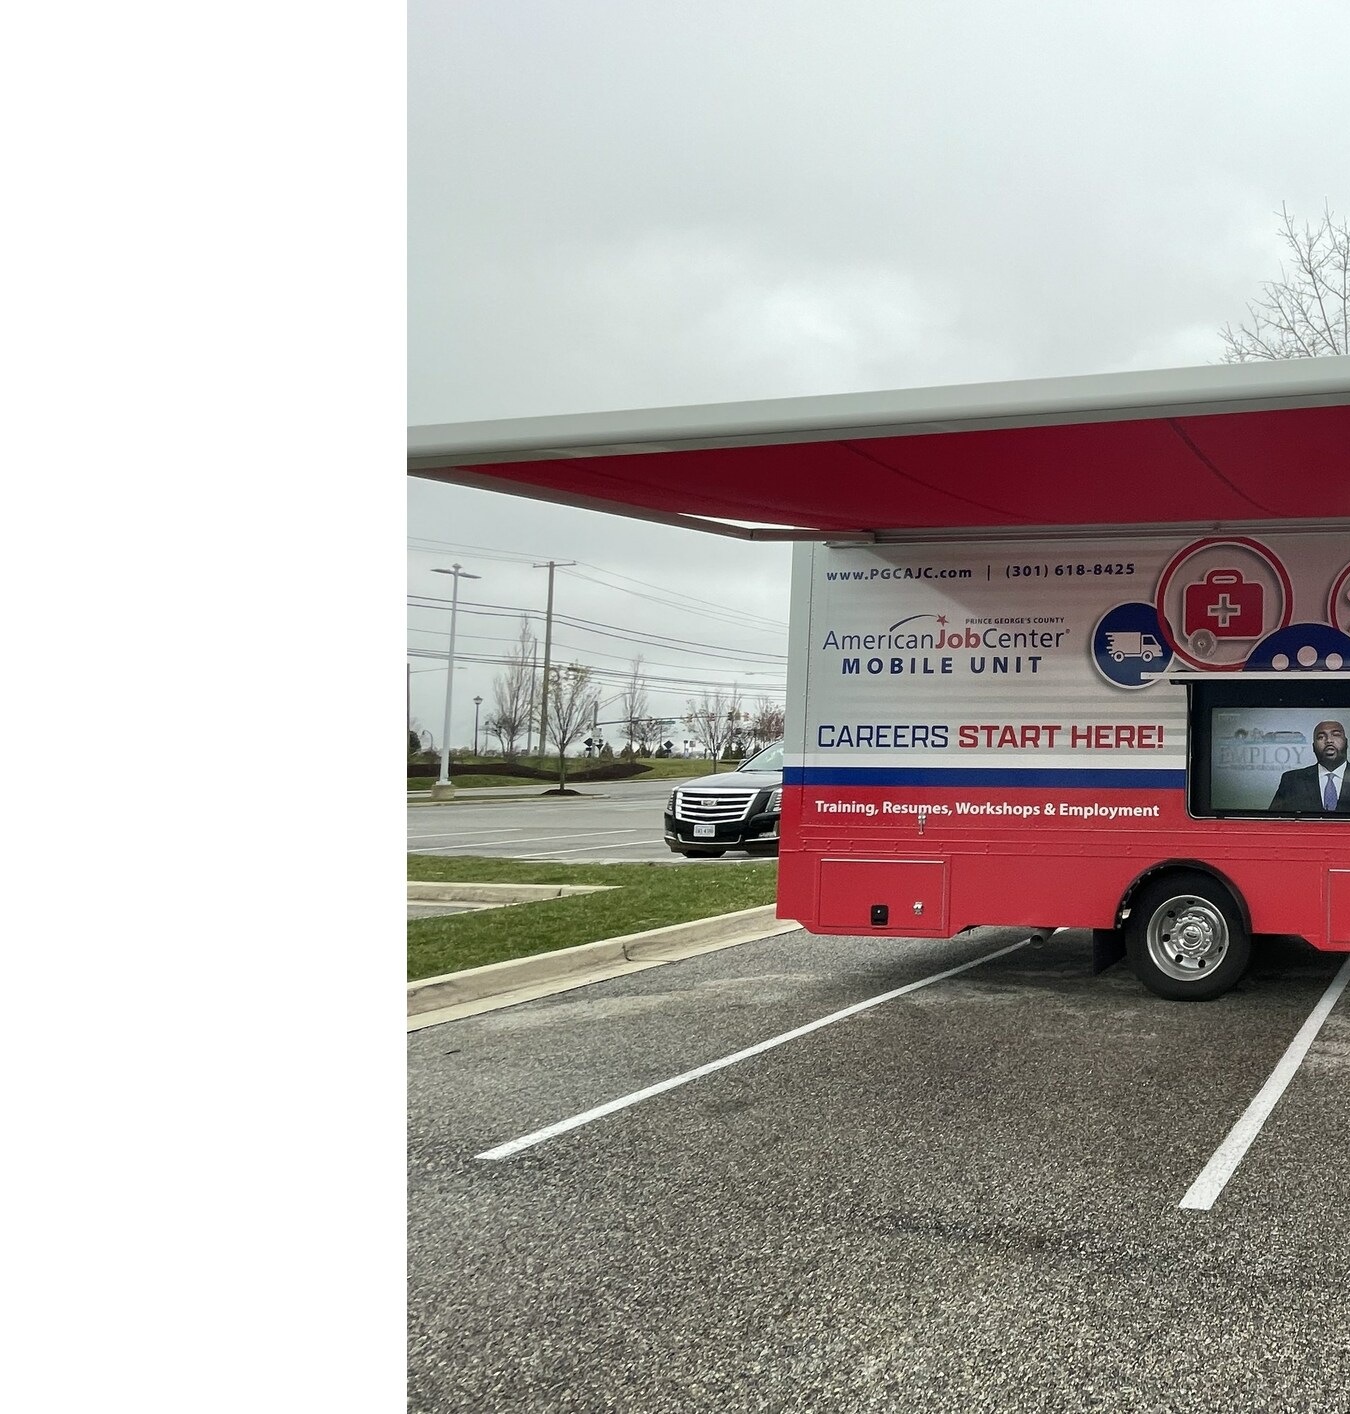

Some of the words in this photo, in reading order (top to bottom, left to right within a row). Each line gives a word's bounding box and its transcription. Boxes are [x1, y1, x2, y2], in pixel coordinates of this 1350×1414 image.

[826, 567, 972, 581] www.PGCAJC.com
[1005, 564, 1049, 578] (301)
[1054, 563, 1135, 576] 618-8425
[994, 617, 1031, 625] GEORGE'S
[842, 657, 953, 675] MOBILE
[970, 656, 1042, 674] UNIT
[818, 725, 949, 748] CAREERS
[958, 725, 1062, 748] START
[1071, 725, 1164, 749] HERE!
[815, 801, 879, 816] Training,
[882, 801, 953, 816] Resumes,
[955, 801, 1041, 818] Workshops
[1043, 802, 1056, 816] &
[1059, 802, 1160, 819] Employment
